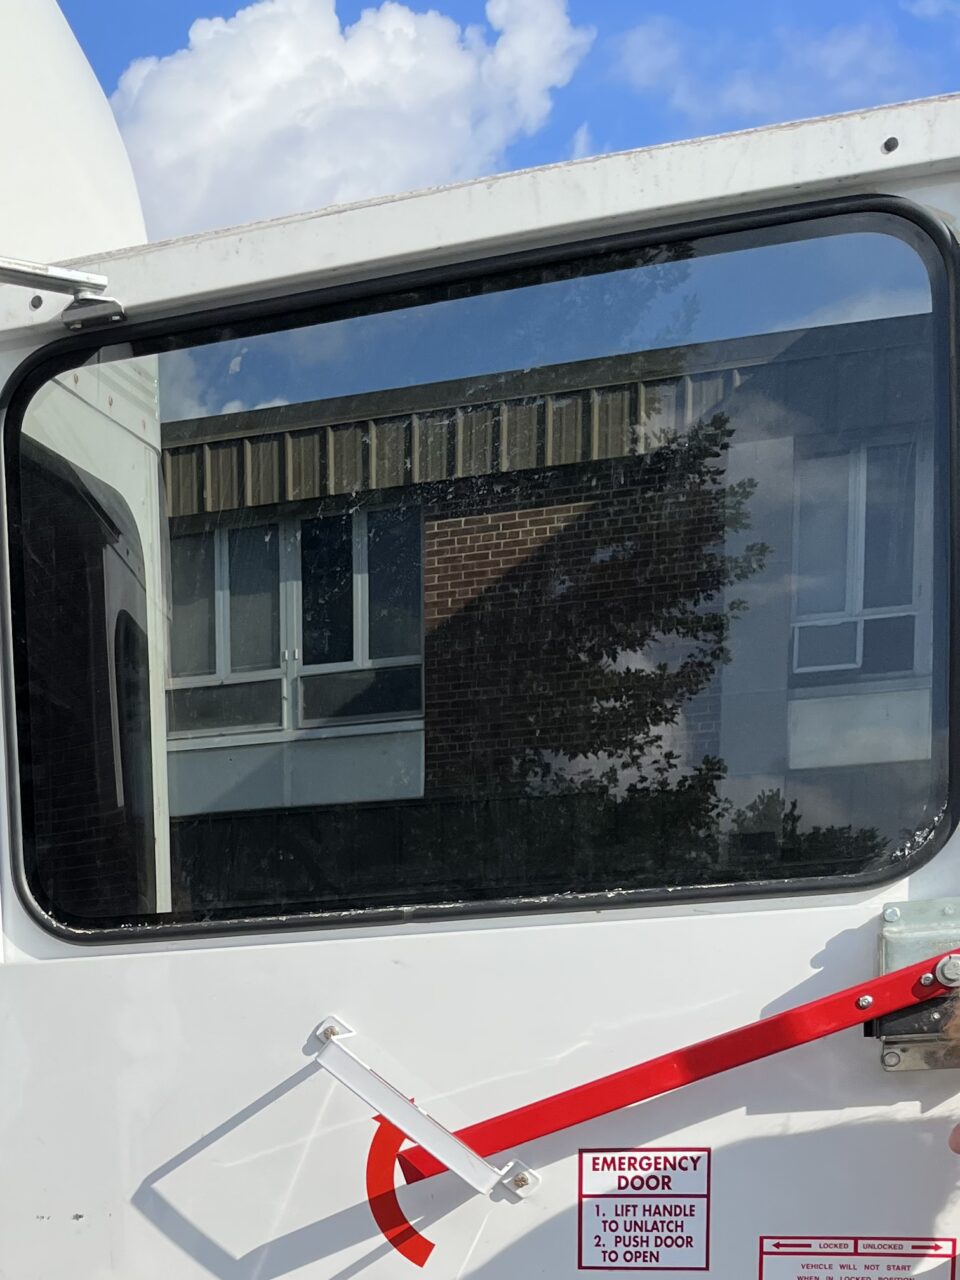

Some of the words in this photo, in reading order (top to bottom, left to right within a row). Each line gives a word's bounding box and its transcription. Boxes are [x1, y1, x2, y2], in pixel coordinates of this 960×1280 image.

[591, 1155, 702, 1172] EMERGENCY
[617, 1174, 673, 1191] DOOR
[594, 1204, 606, 1217] 1.
[614, 1204, 638, 1217] LIFT
[642, 1204, 696, 1217] HANDLE
[601, 1220, 619, 1233] TO
[623, 1220, 684, 1233] UNLATCH
[593, 1234, 606, 1248] 2.
[614, 1235, 650, 1248] PUSH
[654, 1235, 694, 1248] DOOR
[818, 1242, 849, 1250] LOCKED
[862, 1243, 904, 1251] UNLOCKED
[601, 1250, 619, 1263] TO
[623, 1250, 660, 1263] OPEN
[800, 1263, 834, 1271] VEHICLE
[839, 1263, 858, 1271] WILL
